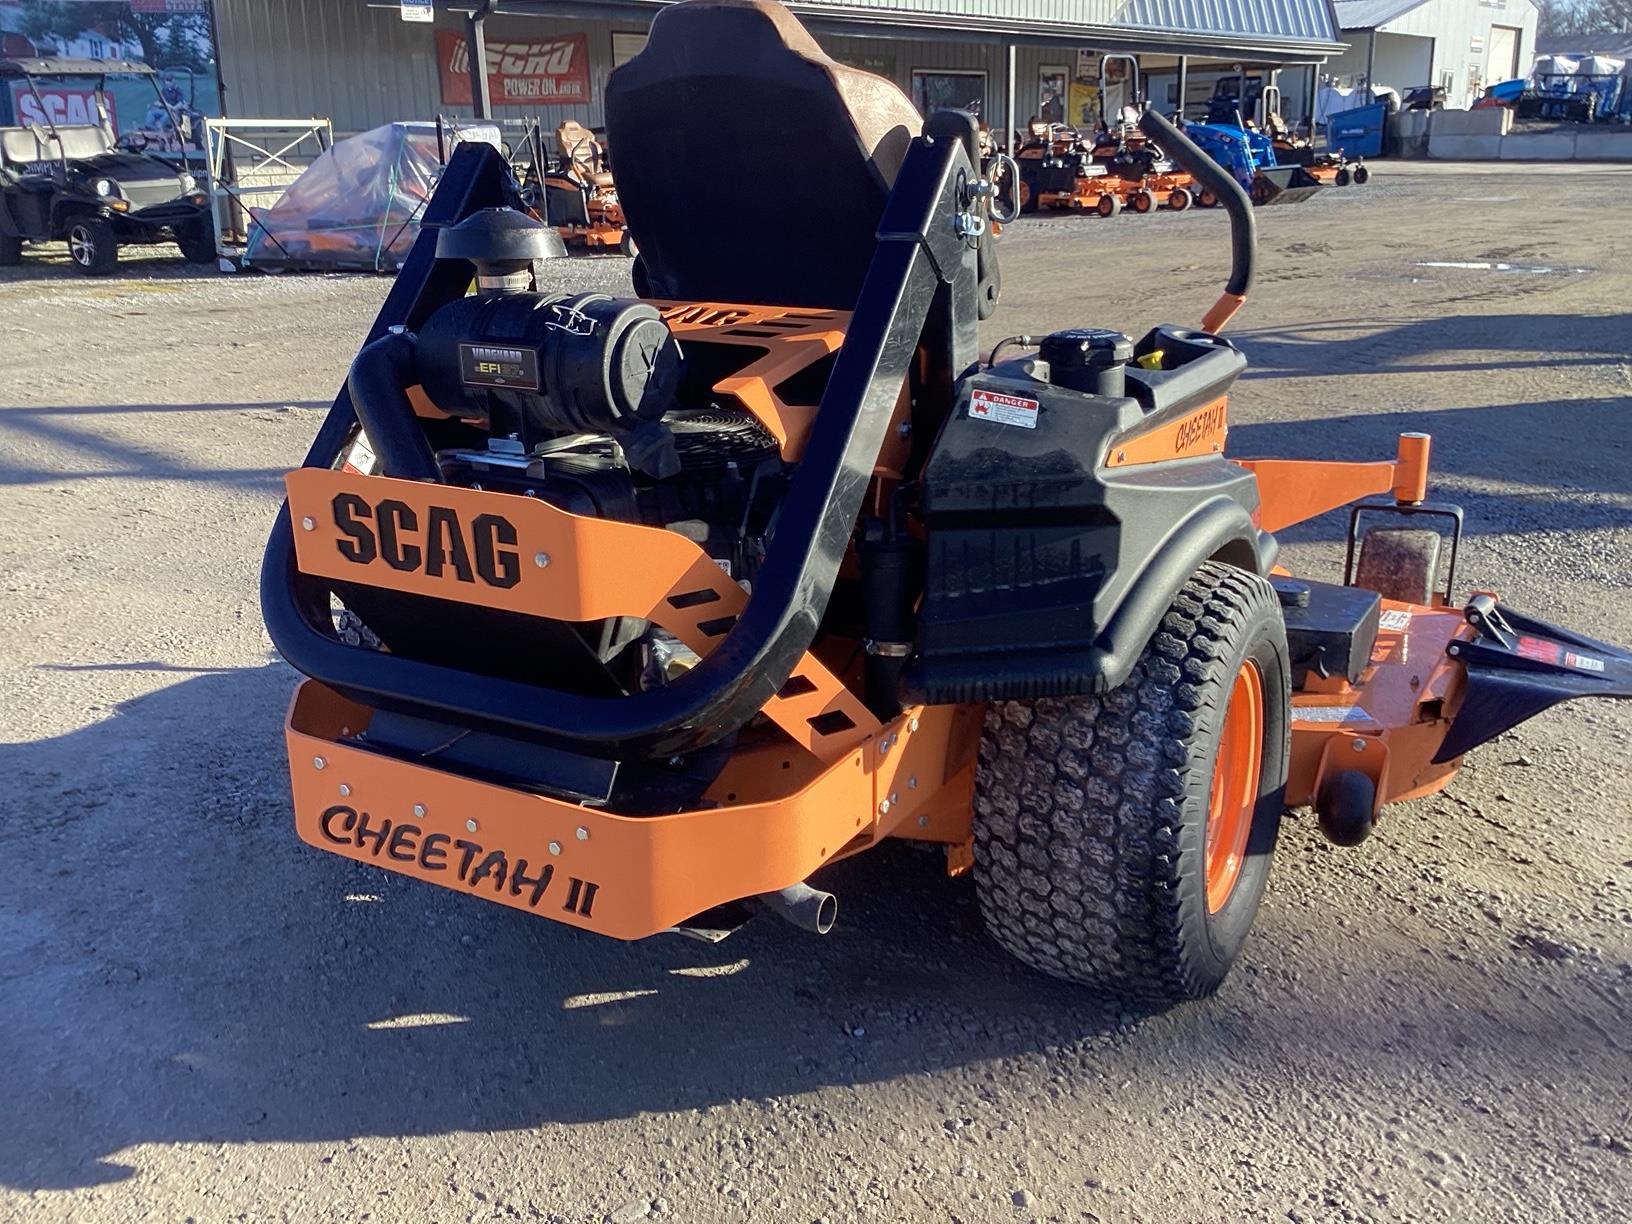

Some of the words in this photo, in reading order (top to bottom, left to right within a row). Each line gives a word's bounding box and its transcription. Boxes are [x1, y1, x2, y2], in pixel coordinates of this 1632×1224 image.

[503, 78, 540, 96] POWER
[472, 347, 523, 363] VANGUARD
[480, 362, 501, 374] EFI
[993, 395, 1029, 408] DANGER
[1175, 405, 1219, 453] CHEETAH
[1218, 406, 1225, 429] II
[331, 491, 522, 590] SCAG
[319, 805, 555, 907] CHEETAH
[562, 877, 600, 919] II
